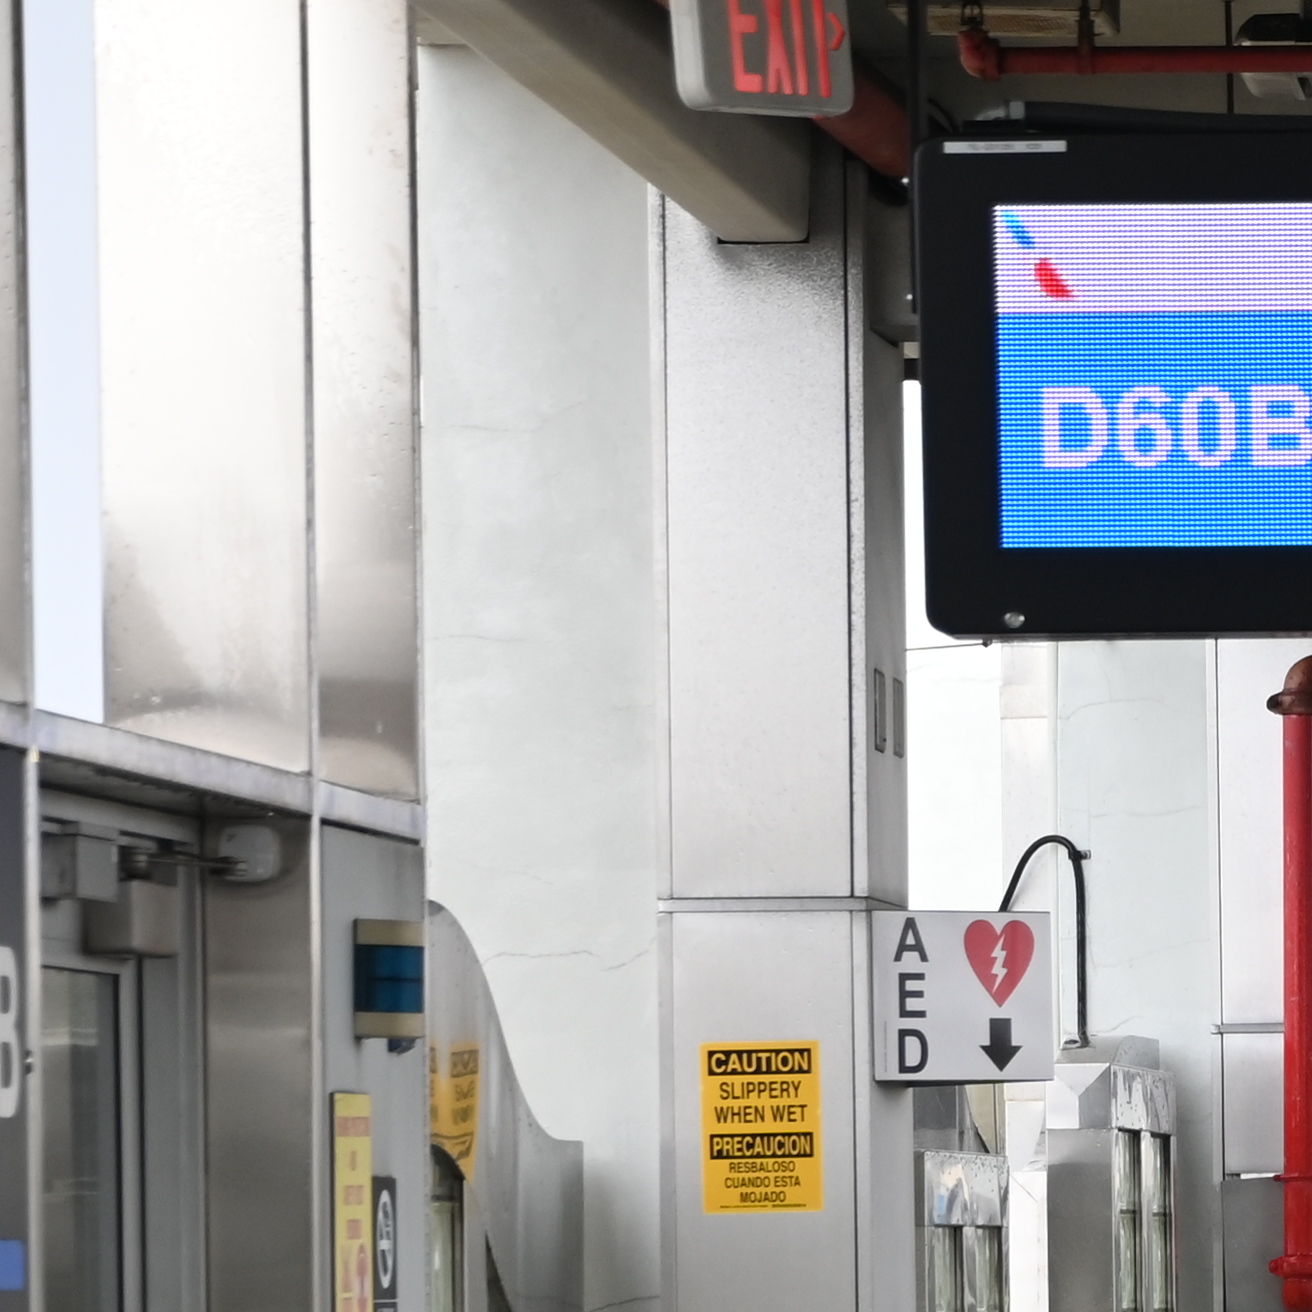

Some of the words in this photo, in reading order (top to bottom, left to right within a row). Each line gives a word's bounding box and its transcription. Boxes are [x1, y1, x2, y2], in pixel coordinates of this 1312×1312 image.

[728, 0, 832, 98] EXIT
[893, 917, 929, 1074] AED
[711, 1052, 810, 1073] CAUTION
[719, 1081, 801, 1100] SLIPPERY
[714, 1106, 765, 1124] WHEN
[770, 1104, 808, 1122] WET
[713, 1136, 810, 1157] PRECAUCION
[729, 1161, 795, 1173] RESBALOSO
[725, 1176, 771, 1188] CUANDO
[774, 1175, 801, 1187] ESTA
[740, 1191, 786, 1203] MOJADO
